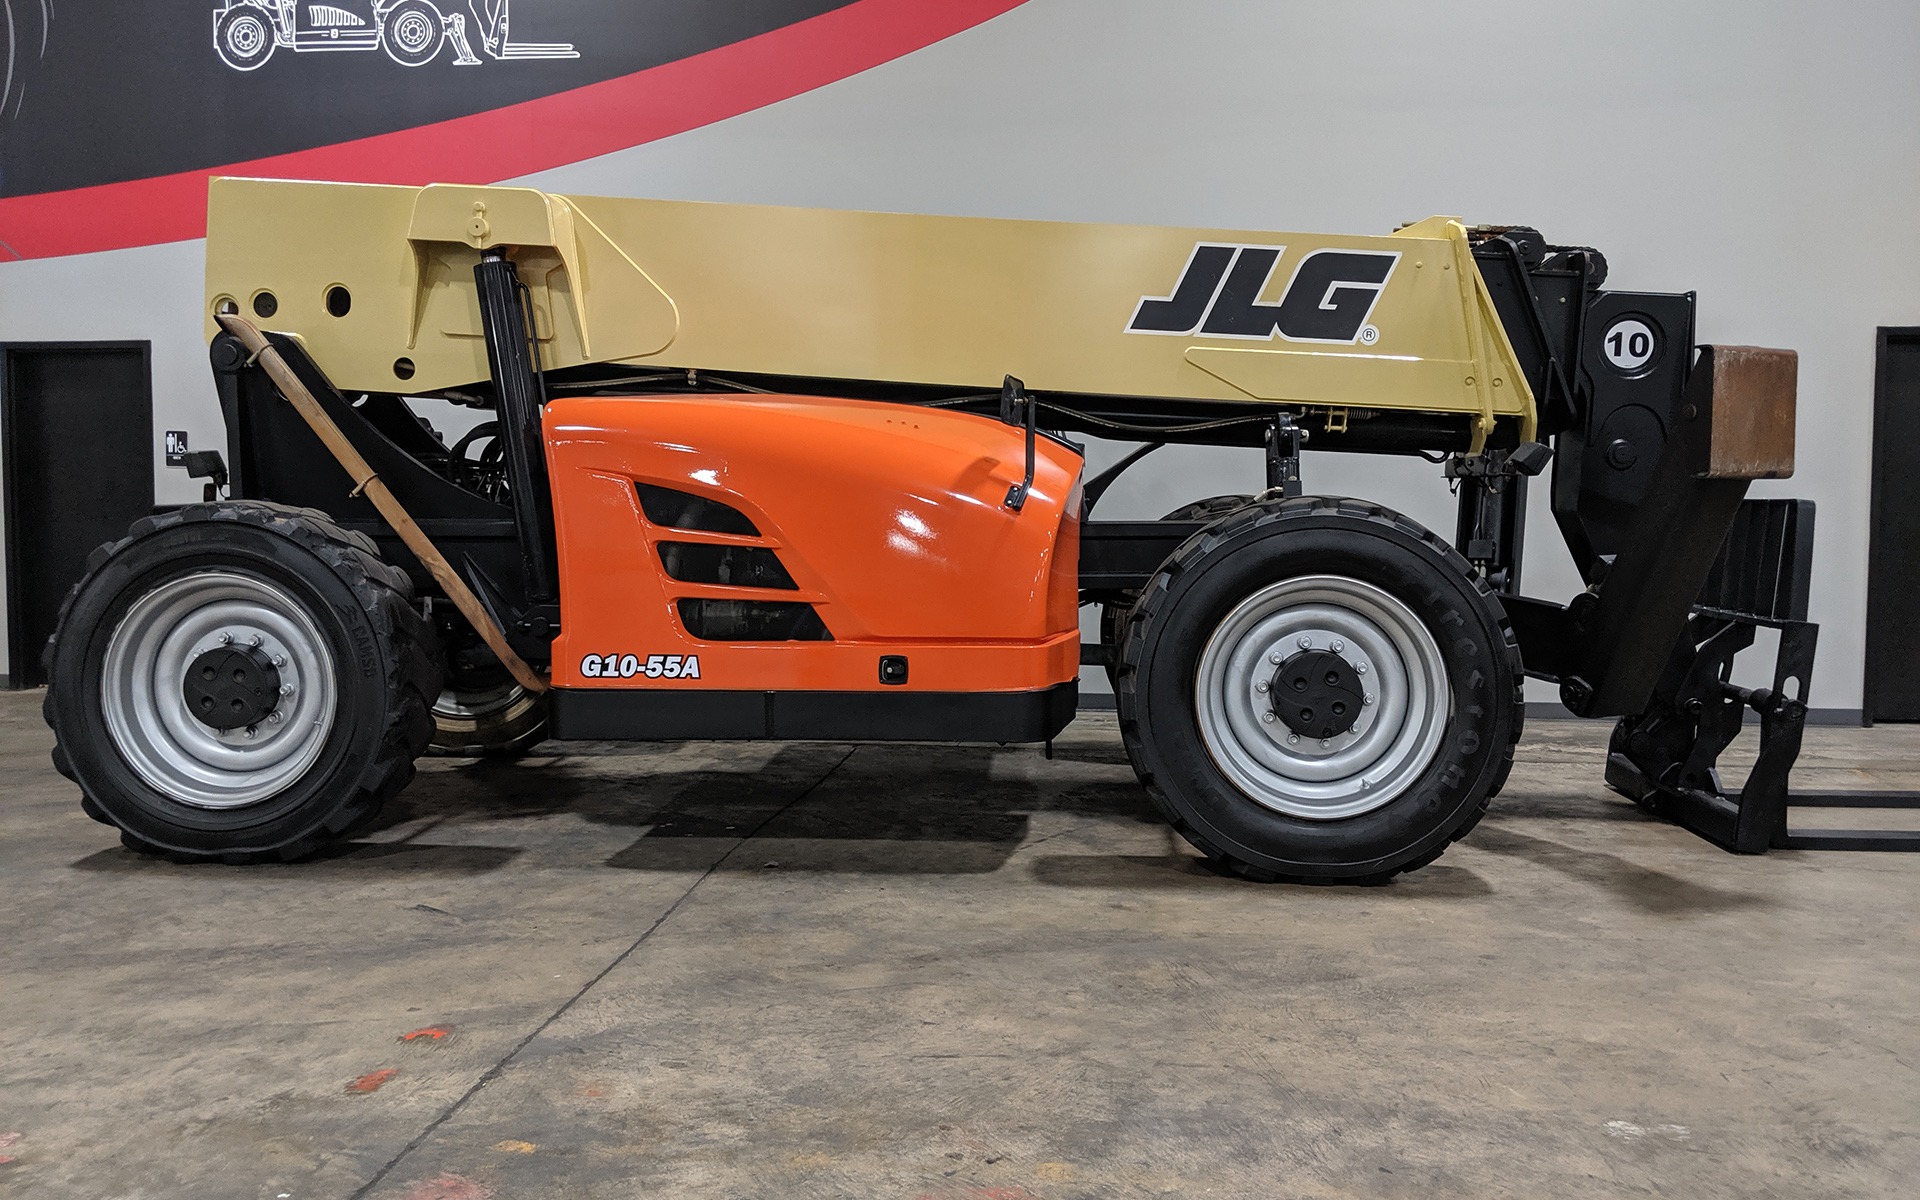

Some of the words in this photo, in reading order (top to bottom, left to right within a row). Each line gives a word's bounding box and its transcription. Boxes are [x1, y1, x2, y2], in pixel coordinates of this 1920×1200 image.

[1124, 242, 1401, 344] JLG
[1607, 331, 1650, 358] 10
[580, 653, 702, 679] G10-55A
